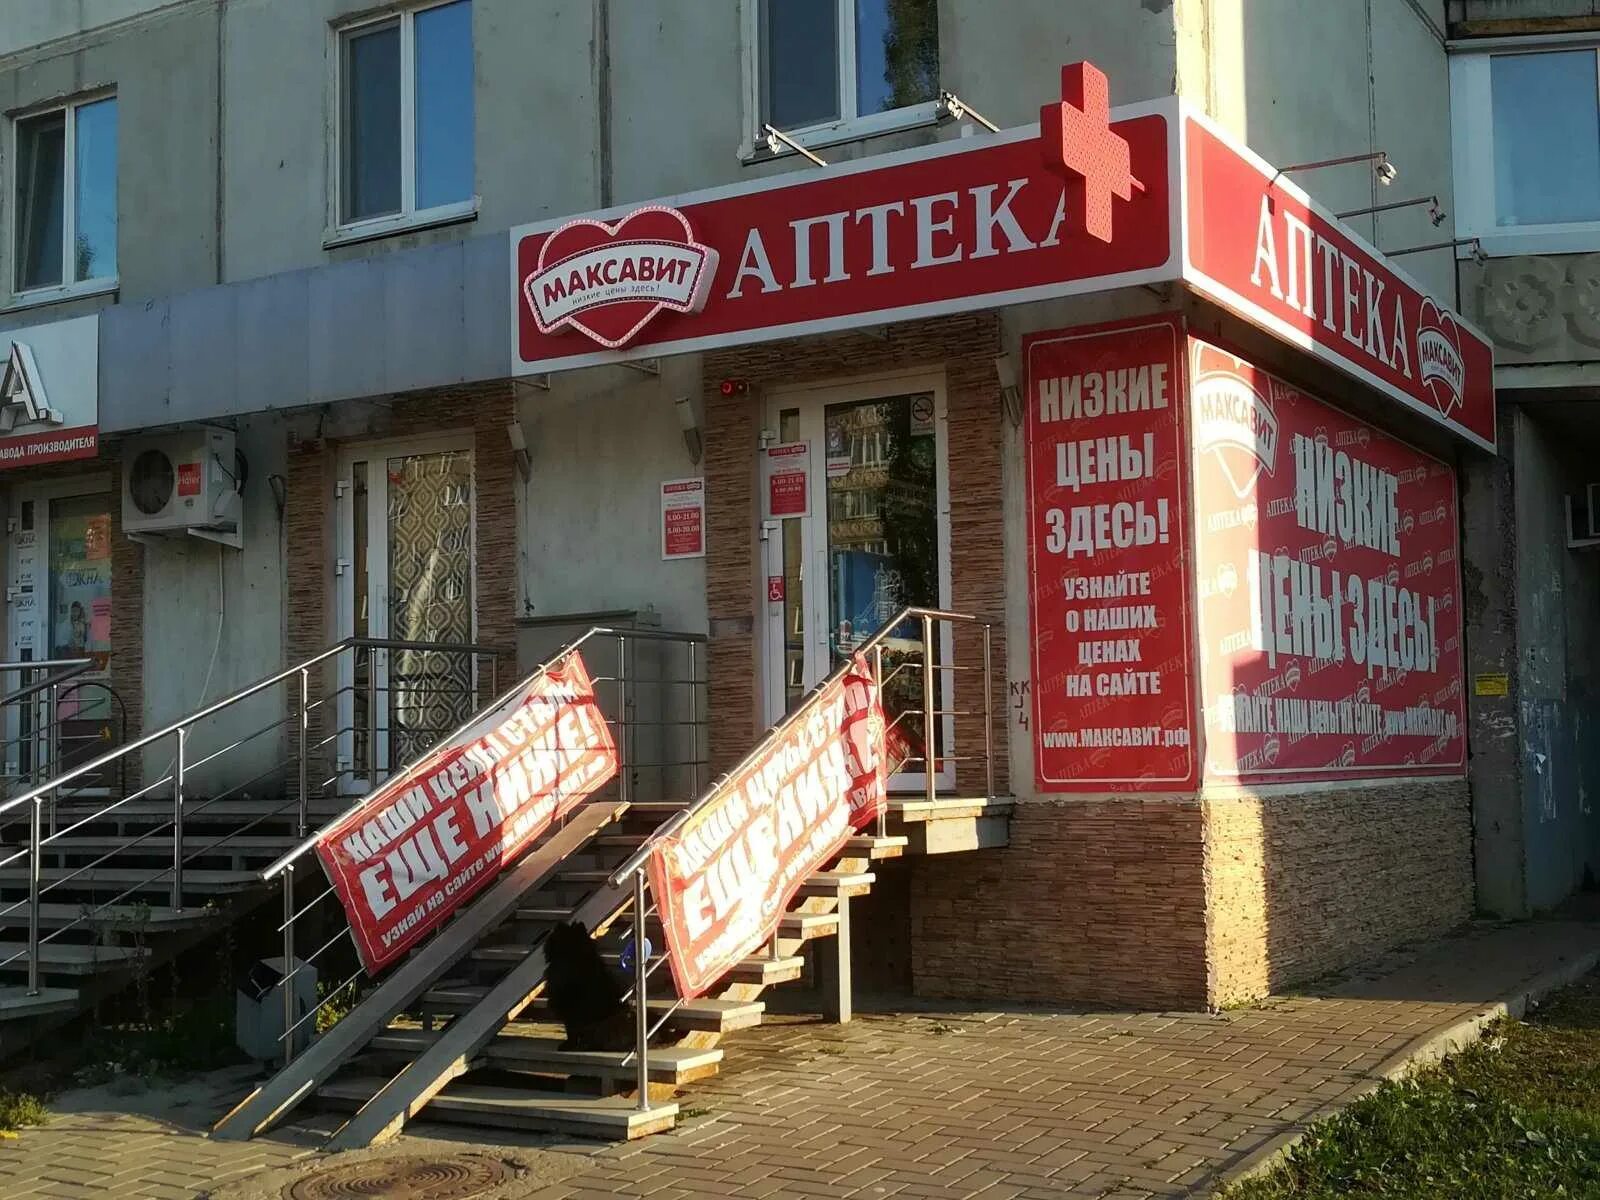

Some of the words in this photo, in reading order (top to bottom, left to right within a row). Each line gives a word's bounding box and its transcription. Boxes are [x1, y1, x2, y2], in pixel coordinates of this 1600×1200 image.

[543, 256, 692, 307] МАКСАВИТ
[572, 291, 601, 305] низкие
[605, 286, 627, 297] цены
[631, 283, 660, 294] здесь!
[1251, 194, 1412, 379] АПТЕКА
[1421, 339, 1461, 386] МАКСАВИТ
[1040, 363, 1169, 424] НИЗКИЕ
[1200, 391, 1275, 450] МАКСАВИТ
[28, 436, 95, 456] ПРОИЗВОДИТЕЛЯ
[1056, 433, 1154, 494] ЦЕНЫ
[1295, 433, 1400, 558] НИЗКИЕ
[1045, 498, 1169, 559] ЗДЕСЬ!
[1064, 569, 1151, 600] УЗНАЙТЕ
[1248, 547, 1345, 670] ЦЕНЫ
[1065, 610, 1079, 632] О
[1084, 605, 1158, 631] НАШИХ
[1066, 674, 1093, 697] НА
[1096, 667, 1162, 696] САЙТЕ
[1078, 640, 1142, 666] ЦЕНАХ
[1043, 726, 1189, 748] www.МАКСАВИТ.рф
[342, 784, 433, 864] НАШИ
[428, 734, 511, 804] ЦЕНЫ
[359, 807, 470, 922] ЕЩЕ
[464, 705, 599, 840] НИЖЕ!
[381, 901, 427, 948] узнай
[427, 888, 446, 909] на
[446, 858, 485, 897] сайте
